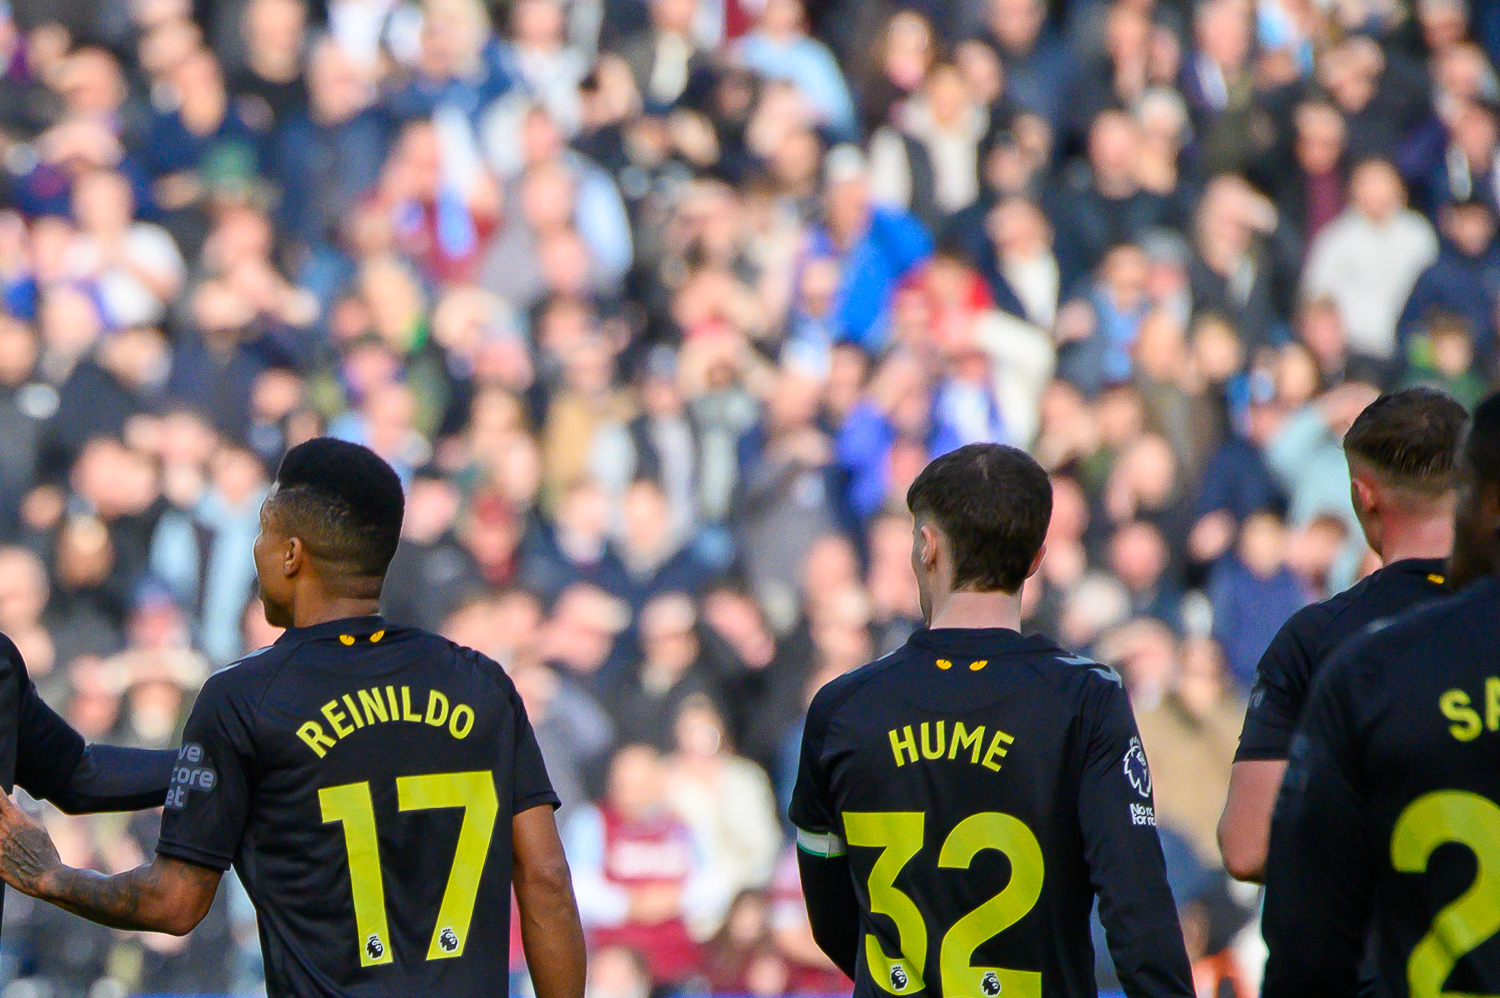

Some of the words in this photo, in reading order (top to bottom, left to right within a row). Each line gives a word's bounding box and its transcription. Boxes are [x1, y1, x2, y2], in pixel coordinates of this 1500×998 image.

[296, 685, 475, 758] REINILDO
[179, 744, 201, 762] ve
[888, 720, 1015, 772] HUME
[164, 785, 185, 807] et
[171, 767, 214, 788] ore
[318, 770, 499, 968] 17
